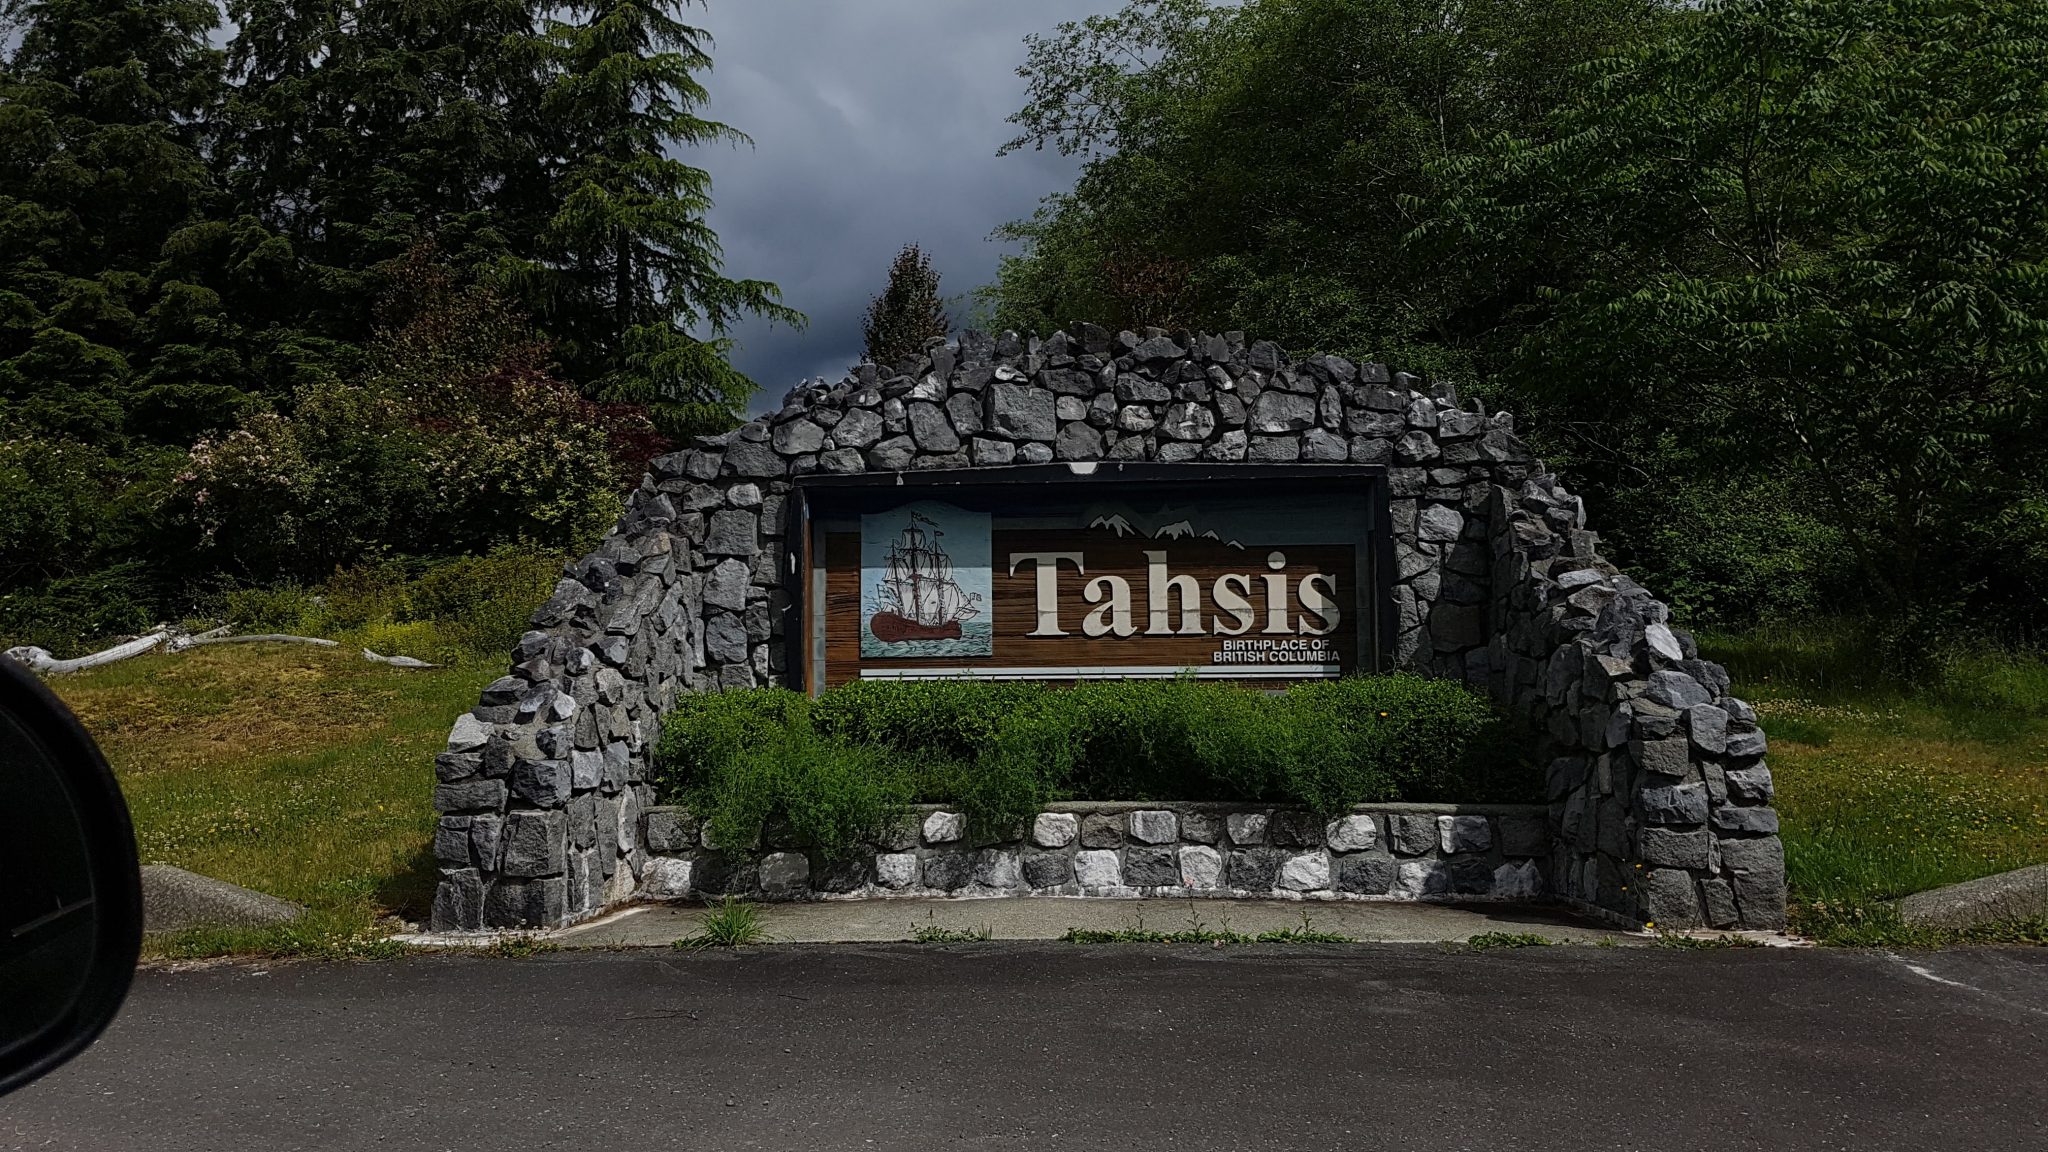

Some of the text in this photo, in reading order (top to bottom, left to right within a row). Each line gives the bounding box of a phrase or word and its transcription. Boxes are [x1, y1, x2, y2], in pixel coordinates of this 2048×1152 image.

[1009, 550, 1341, 638] Tahsis
[1223, 640, 1329, 651] BIRTHPLACE OF
[1213, 651, 1340, 662] BRITISH COLUMBIA
